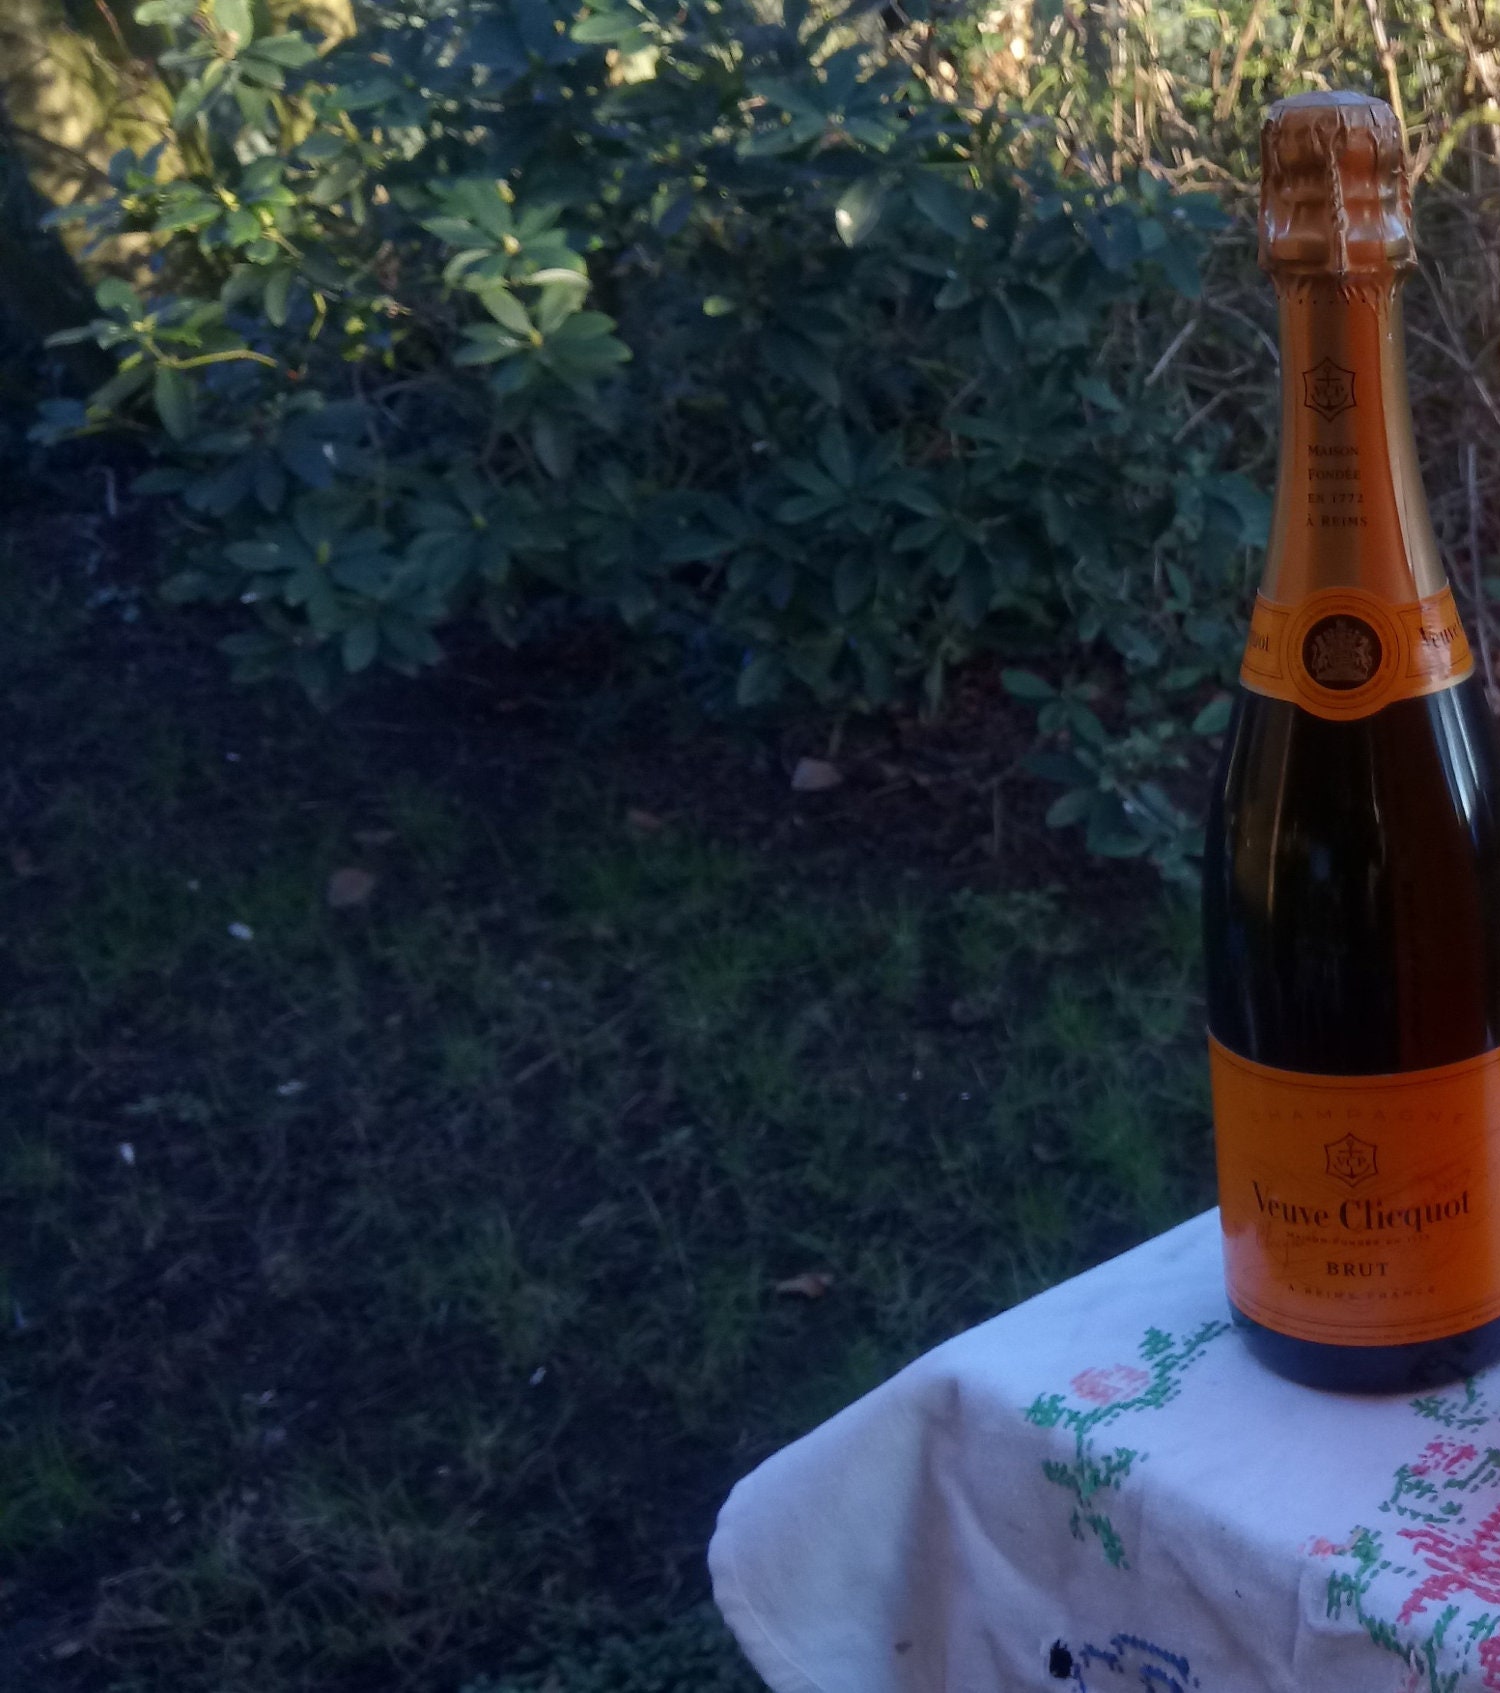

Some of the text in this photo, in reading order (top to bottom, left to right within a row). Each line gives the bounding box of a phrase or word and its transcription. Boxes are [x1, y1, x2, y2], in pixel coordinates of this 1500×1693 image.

[1252, 1180, 1470, 1233] Veuve Clicquot
[1326, 1261, 1388, 1277] BRUT
